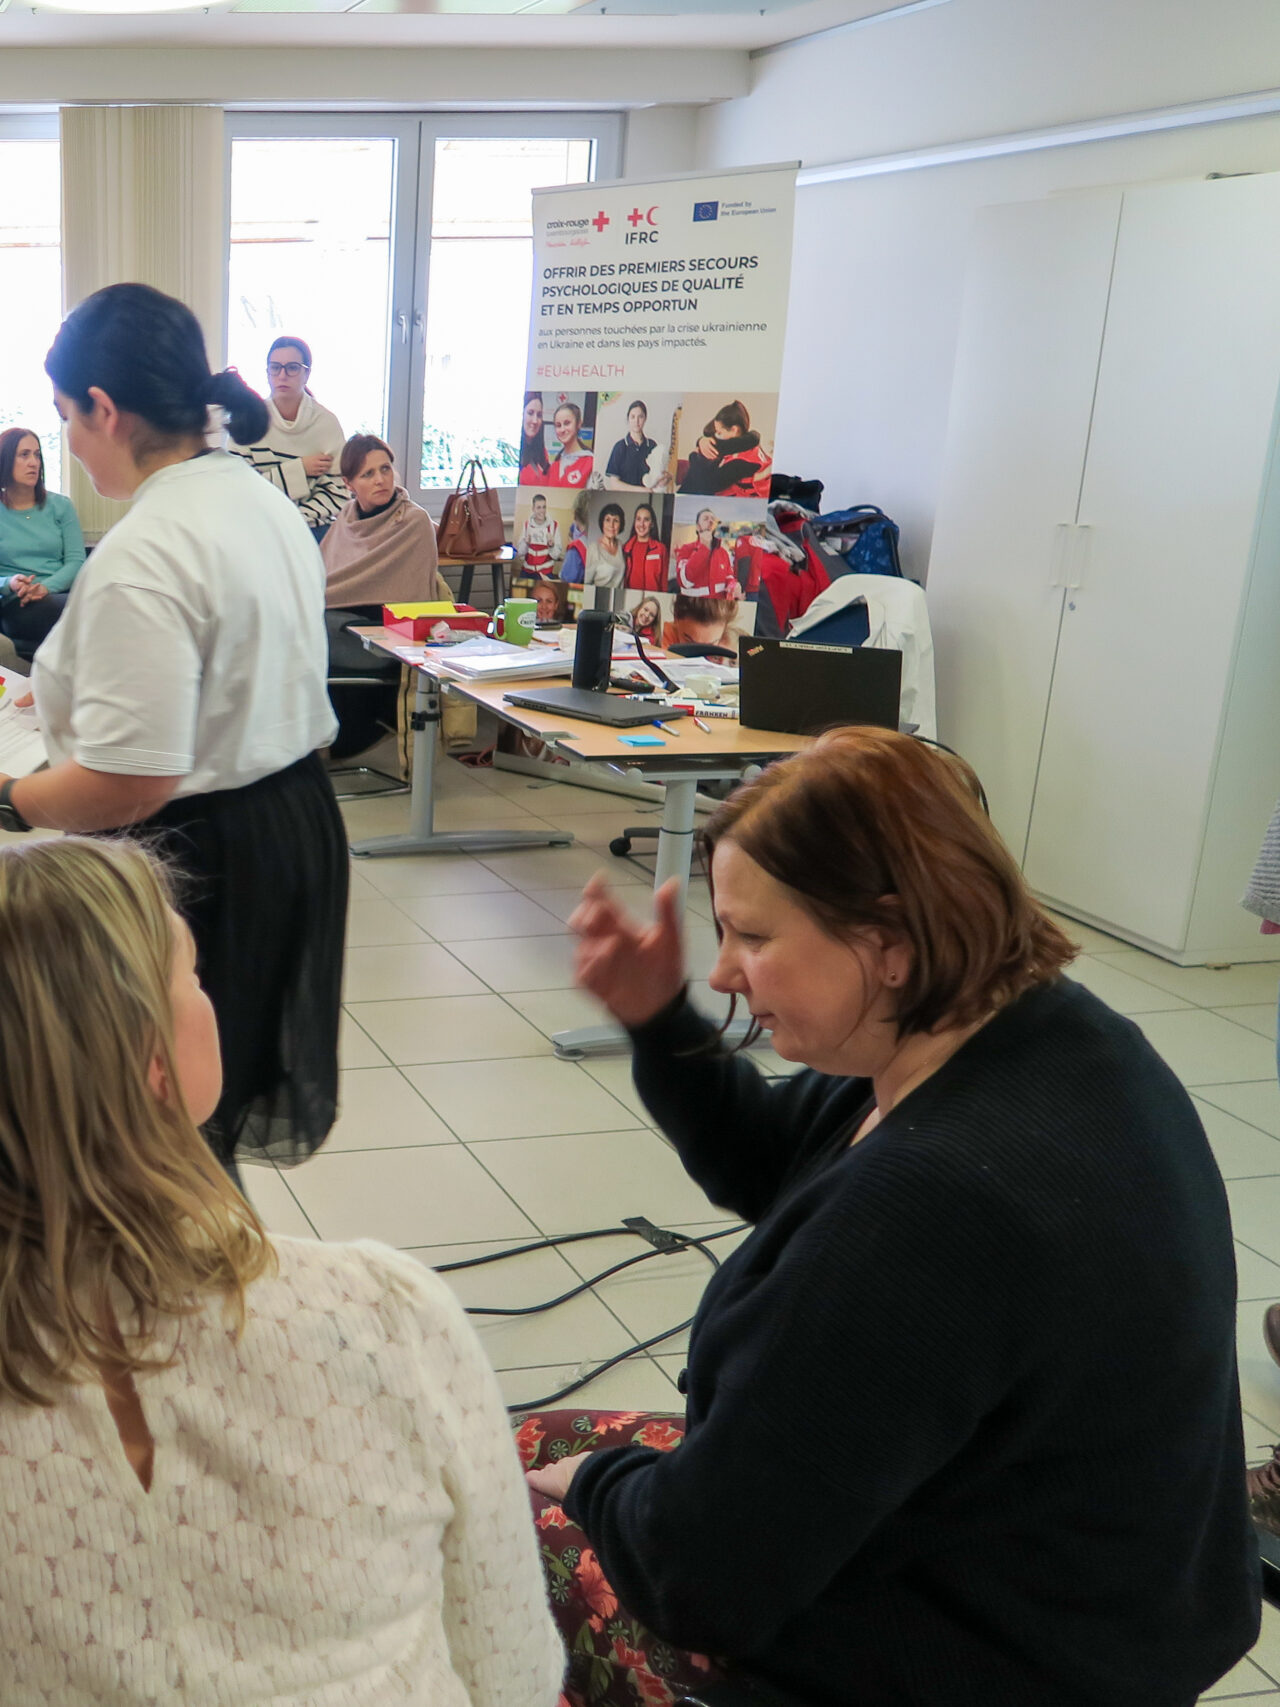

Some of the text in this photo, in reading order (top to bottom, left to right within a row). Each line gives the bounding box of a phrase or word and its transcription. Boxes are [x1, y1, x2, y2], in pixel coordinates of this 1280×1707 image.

[546, 219, 589, 230] croix-rouge
[625, 231, 659, 245] IFRC
[543, 256, 759, 279] OFFRIR DES PREMIERS SECOURS
[542, 274, 744, 297] PSYCHOLOGIQUES DE QUALITÉ
[541, 298, 698, 316] ET EN TEMPS OPPORTUN
[538, 321, 768, 338] aux personnes touchées par la crise ukrainienne
[537, 337, 707, 350] en Ukraine et dans les pays impactés.
[537, 364, 625, 378] #EU4HEALTH
[695, 710, 728, 718] FRANKEN
